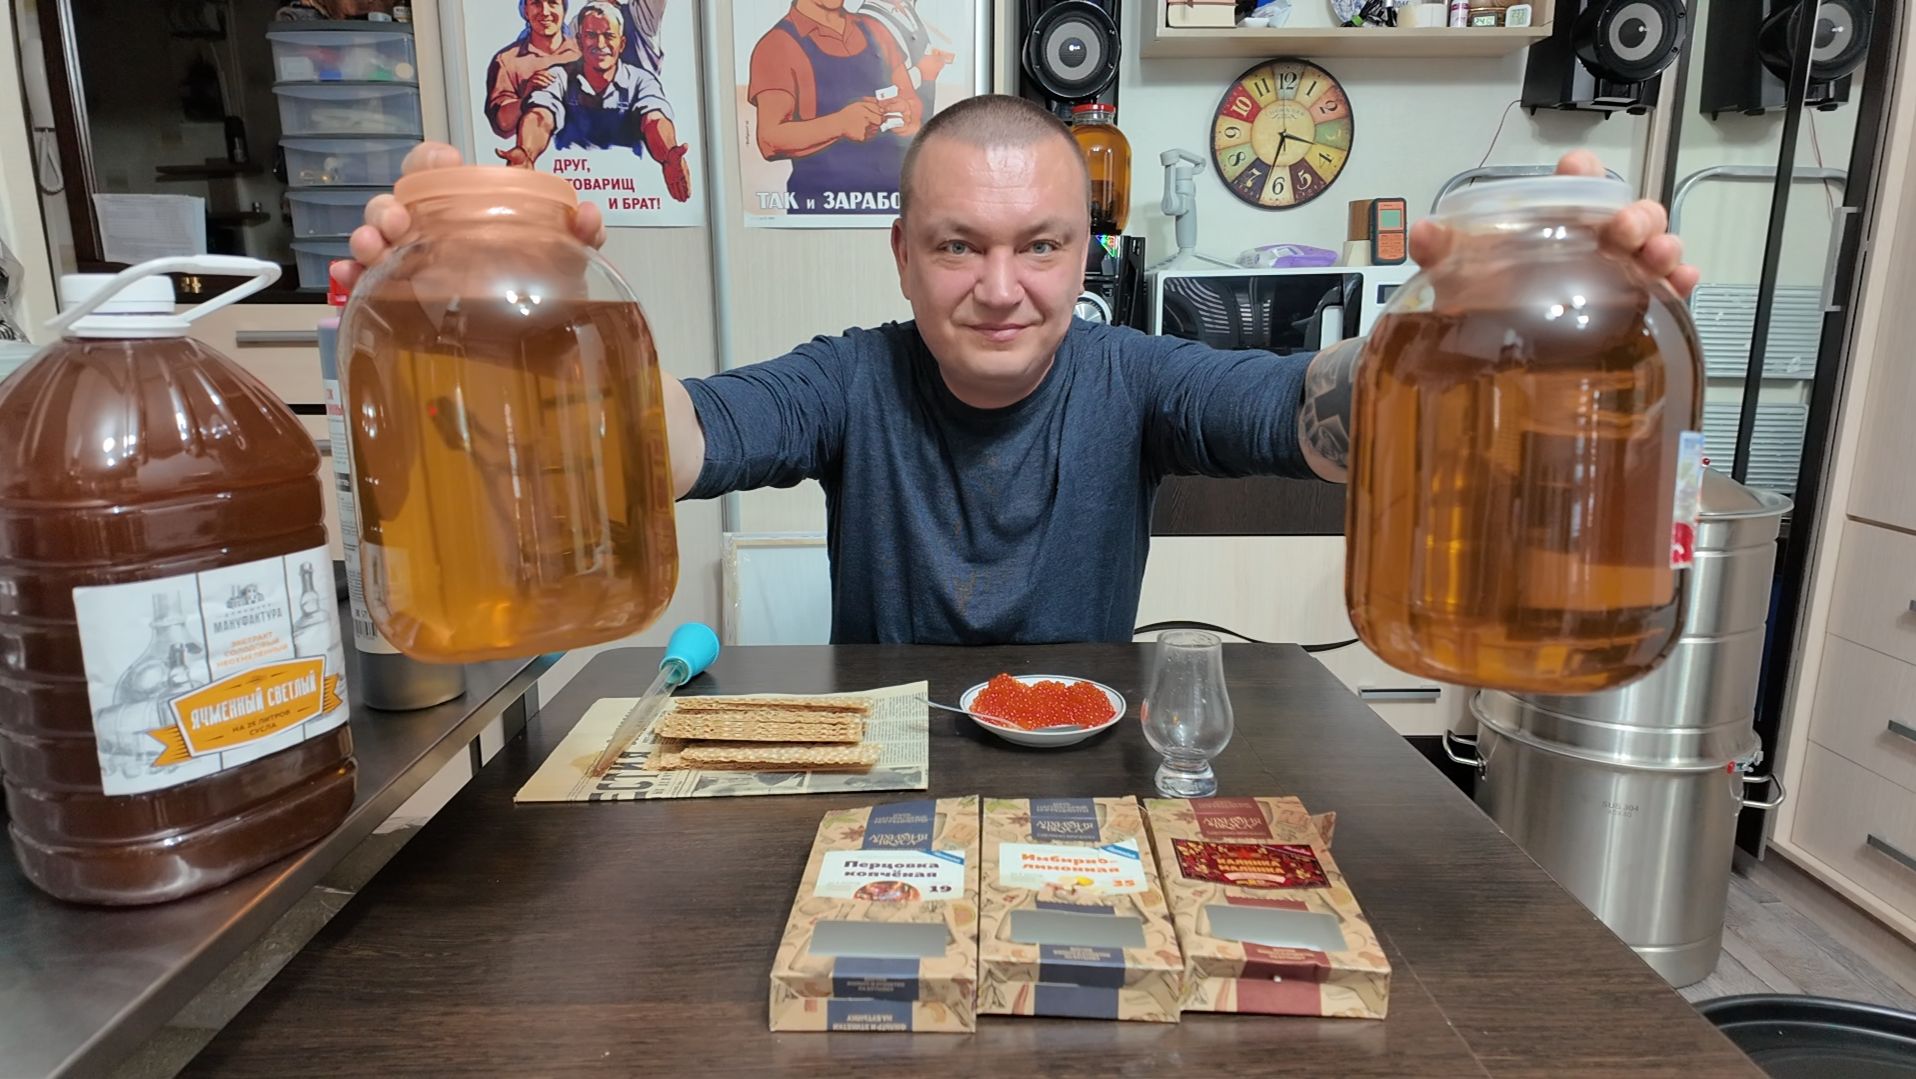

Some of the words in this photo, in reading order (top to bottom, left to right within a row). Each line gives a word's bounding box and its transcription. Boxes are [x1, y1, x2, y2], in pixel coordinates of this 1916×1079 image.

[1253, 78, 1271, 97] 11
[1279, 72, 1297, 90] 12
[1306, 81, 1317, 97] 1
[1231, 96, 1253, 117] 10
[1320, 100, 1338, 114] 2
[1224, 126, 1242, 140] 9
[553, 159, 591, 173] ДРУГ,
[1228, 151, 1247, 167] 8
[1318, 152, 1334, 169] 4
[1244, 168, 1262, 188] 7
[1272, 177, 1285, 195] 6
[1297, 170, 1312, 190] 5
[608, 198, 618, 209] И
[622, 198, 661, 209] БРАТ!
[756, 192, 799, 209] ТАК
[806, 198, 816, 209] и
[823, 191, 900, 210] ЗАРАБО
[213, 607, 282, 634] МАНУФАКТУРА
[191, 687, 264, 730] ЯЧМЕННЫЙ
[267, 670, 317, 706] СВЕТЛЫЙ
[258, 709, 291, 723] ЛИТРОВ
[249, 722, 277, 736] СУСЛА
[844, 860, 940, 869] Перцовка
[1023, 863, 1120, 873] лимонная
[930, 885, 952, 893] 19
